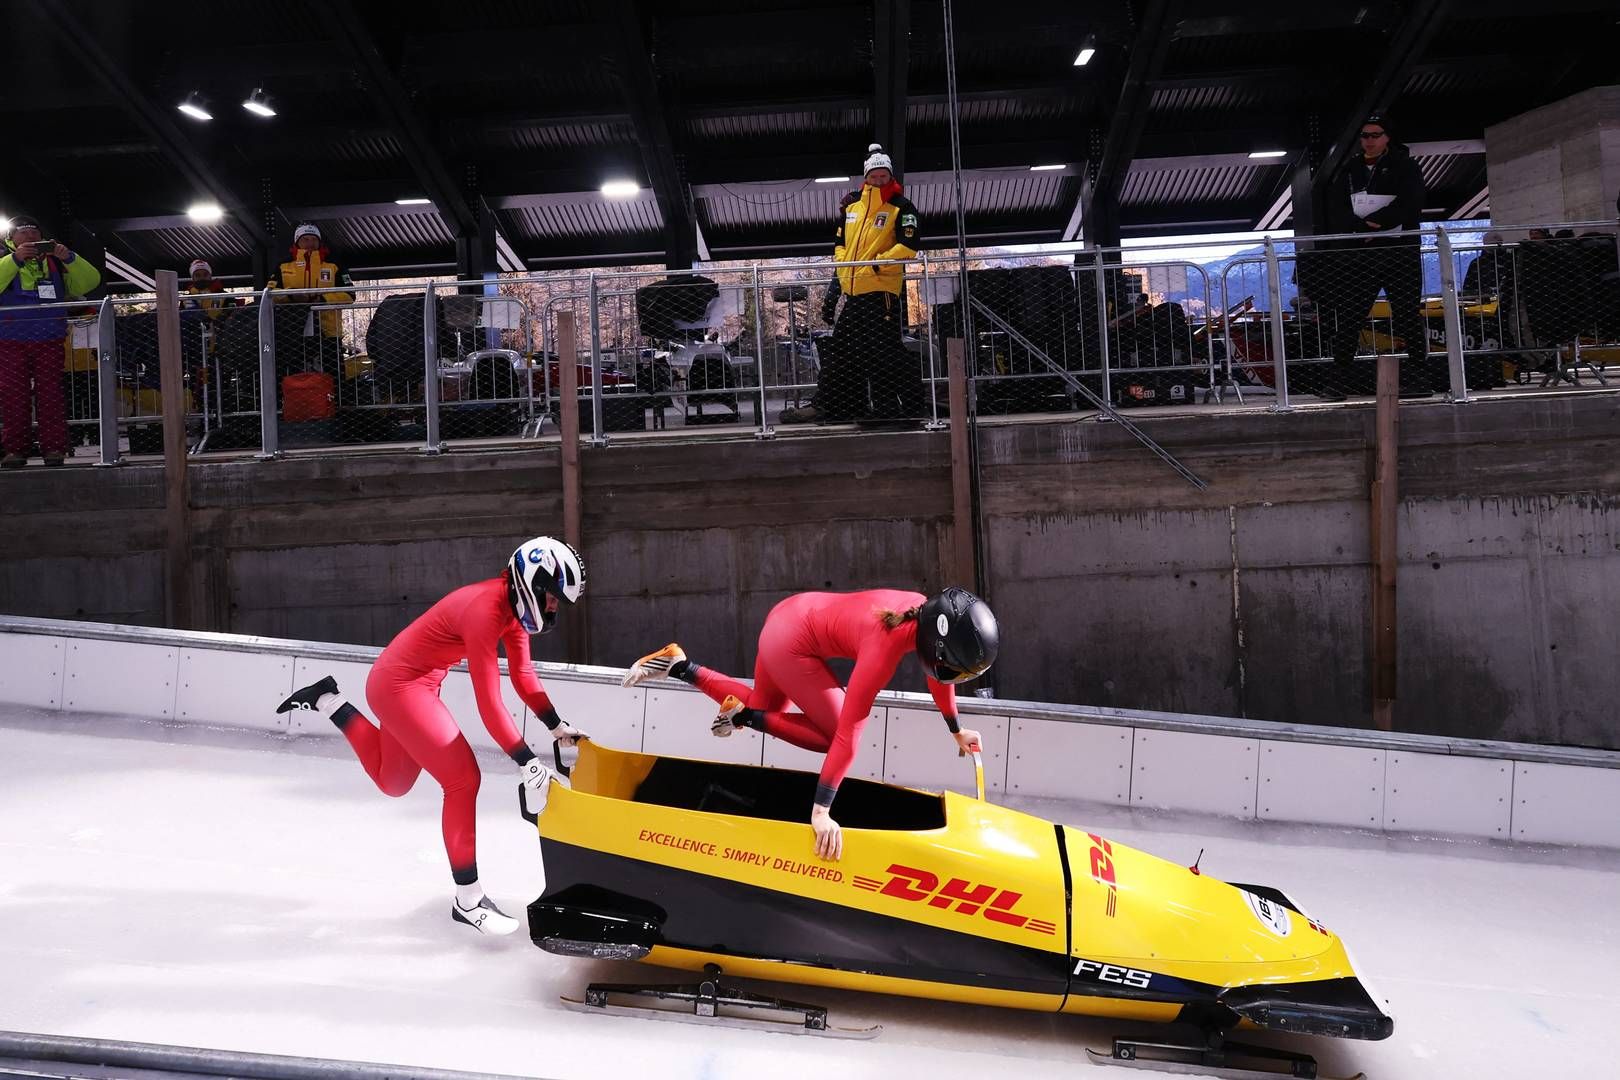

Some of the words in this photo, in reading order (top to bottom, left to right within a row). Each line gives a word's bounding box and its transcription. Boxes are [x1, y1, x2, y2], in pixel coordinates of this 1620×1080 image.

[638, 829, 718, 857] EXCELLENCE.
[722, 846, 771, 868] SIMPLY
[772, 858, 846, 884] DELIVERED.
[879, 864, 1030, 929] DHL
[1072, 959, 1153, 989] FES
